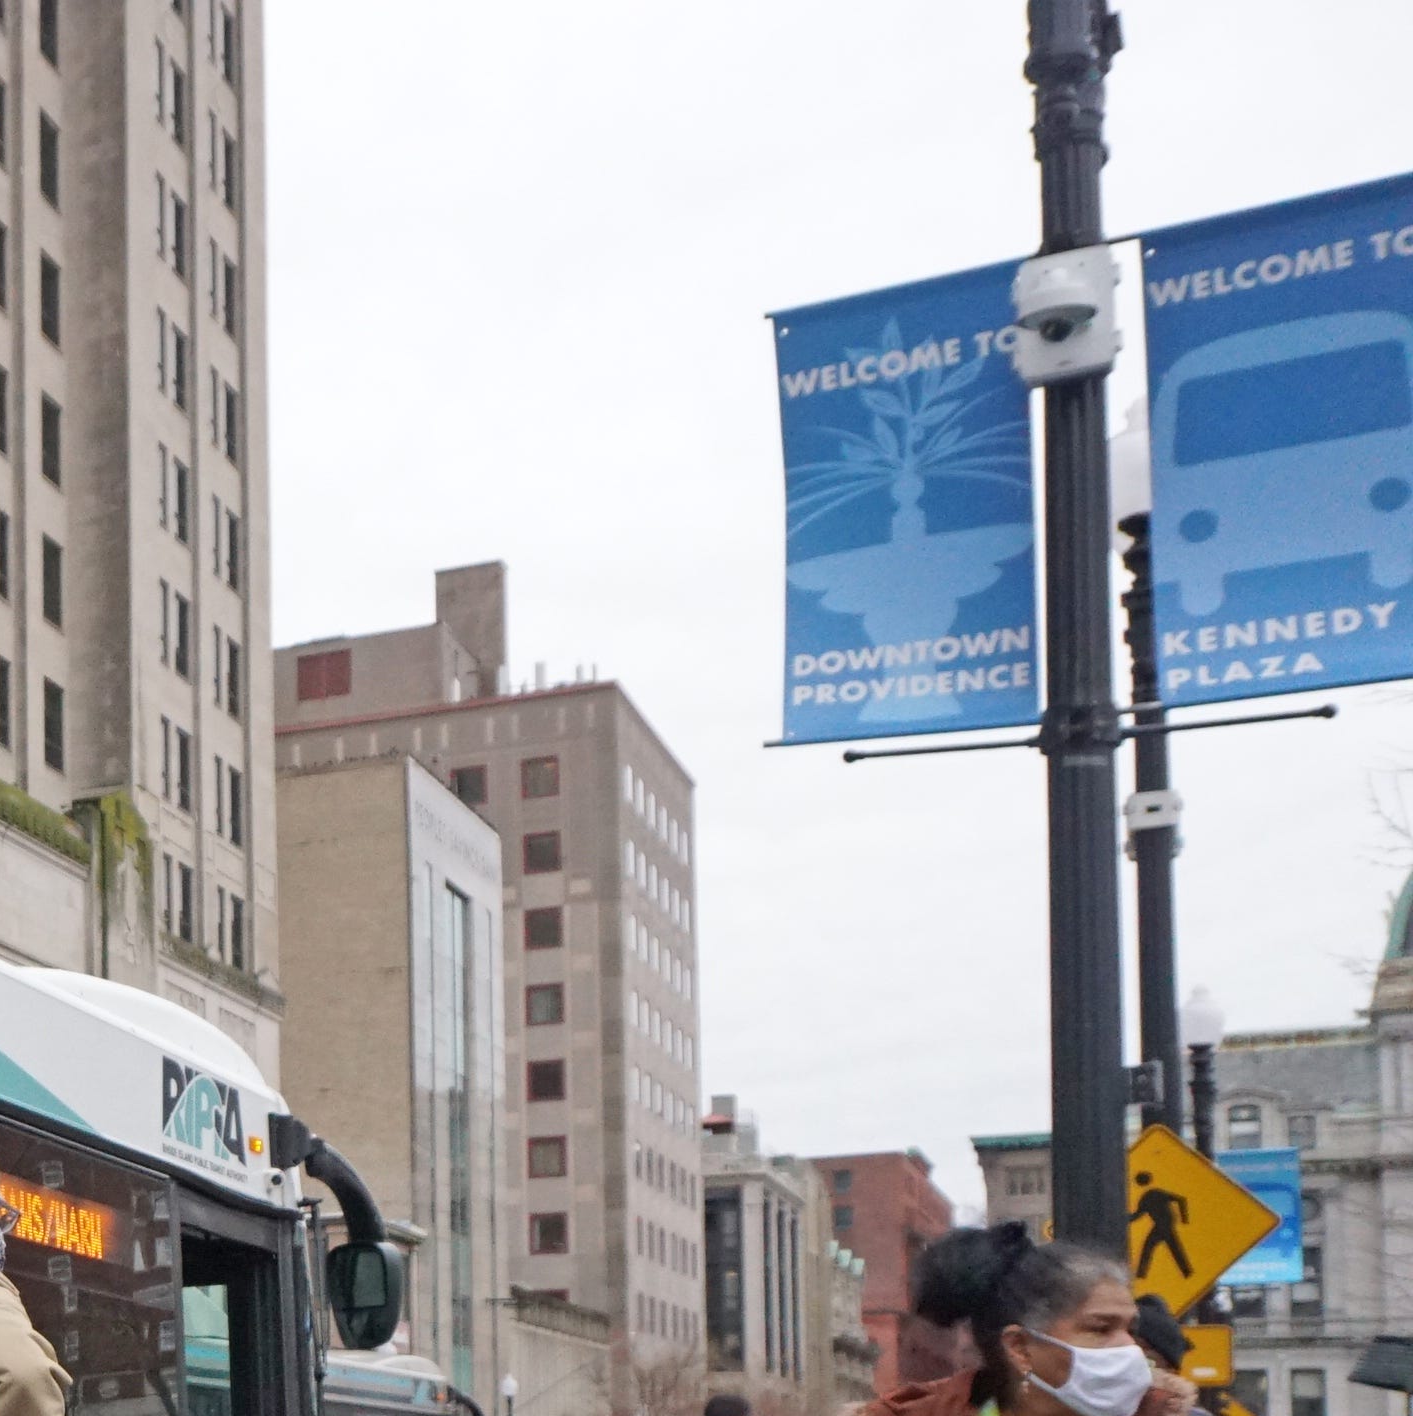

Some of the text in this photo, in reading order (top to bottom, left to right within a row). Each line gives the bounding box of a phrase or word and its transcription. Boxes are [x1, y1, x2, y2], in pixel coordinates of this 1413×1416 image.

[1149, 225, 1413, 306] WELCOME TO
[781, 324, 1018, 399] WELCOME TO
[793, 626, 1030, 678] DOWNTOWN
[1165, 602, 1398, 657] KENNEDY
[793, 661, 1030, 706] PROVIDENCE
[1165, 653, 1324, 690] PLAZA
